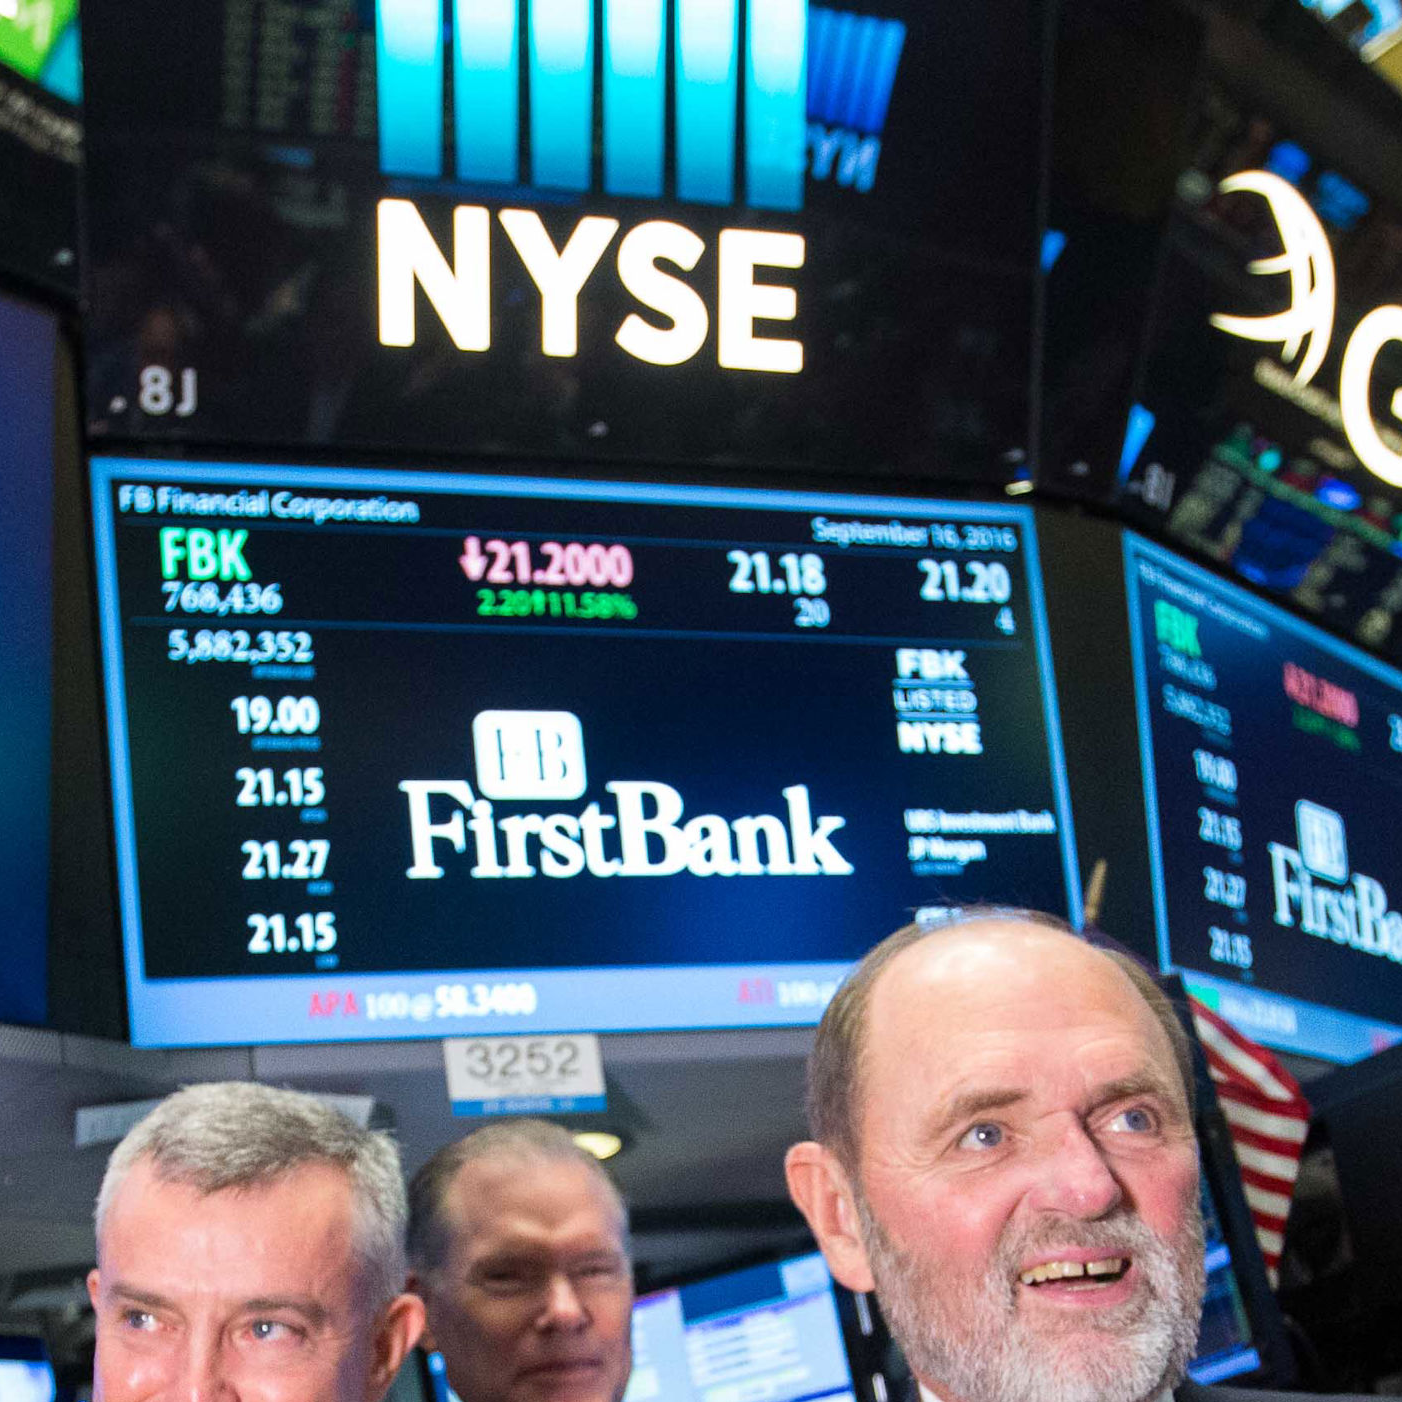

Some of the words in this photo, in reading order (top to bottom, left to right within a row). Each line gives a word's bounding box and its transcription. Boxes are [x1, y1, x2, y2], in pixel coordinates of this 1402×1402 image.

[377, 198, 806, 374] NYSE
[118, 485, 155, 514] FB
[156, 486, 270, 519] Financial
[271, 491, 421, 525] Corporation
[810, 516, 929, 548] September
[160, 527, 252, 581] FBK
[484, 539, 634, 588] 21.2000
[727, 549, 827, 595] 21.18
[917, 558, 1011, 604] 21.20
[160, 580, 283, 617] 768,436
[793, 597, 831, 628] 20
[995, 606, 1016, 635] 4
[167, 628, 315, 664] 5,882,352
[895, 648, 970, 680] FBK
[230, 695, 321, 735] 19.00
[893, 690, 978, 713] LISTED
[896, 721, 984, 755] NYSE
[235, 767, 326, 807] 21.15
[400, 777, 853, 879] FirstBank
[241, 839, 331, 880] 21.27
[246, 911, 337, 954] 21.15
[308, 989, 359, 1019] APA
[464, 1039, 582, 1080] 3252
